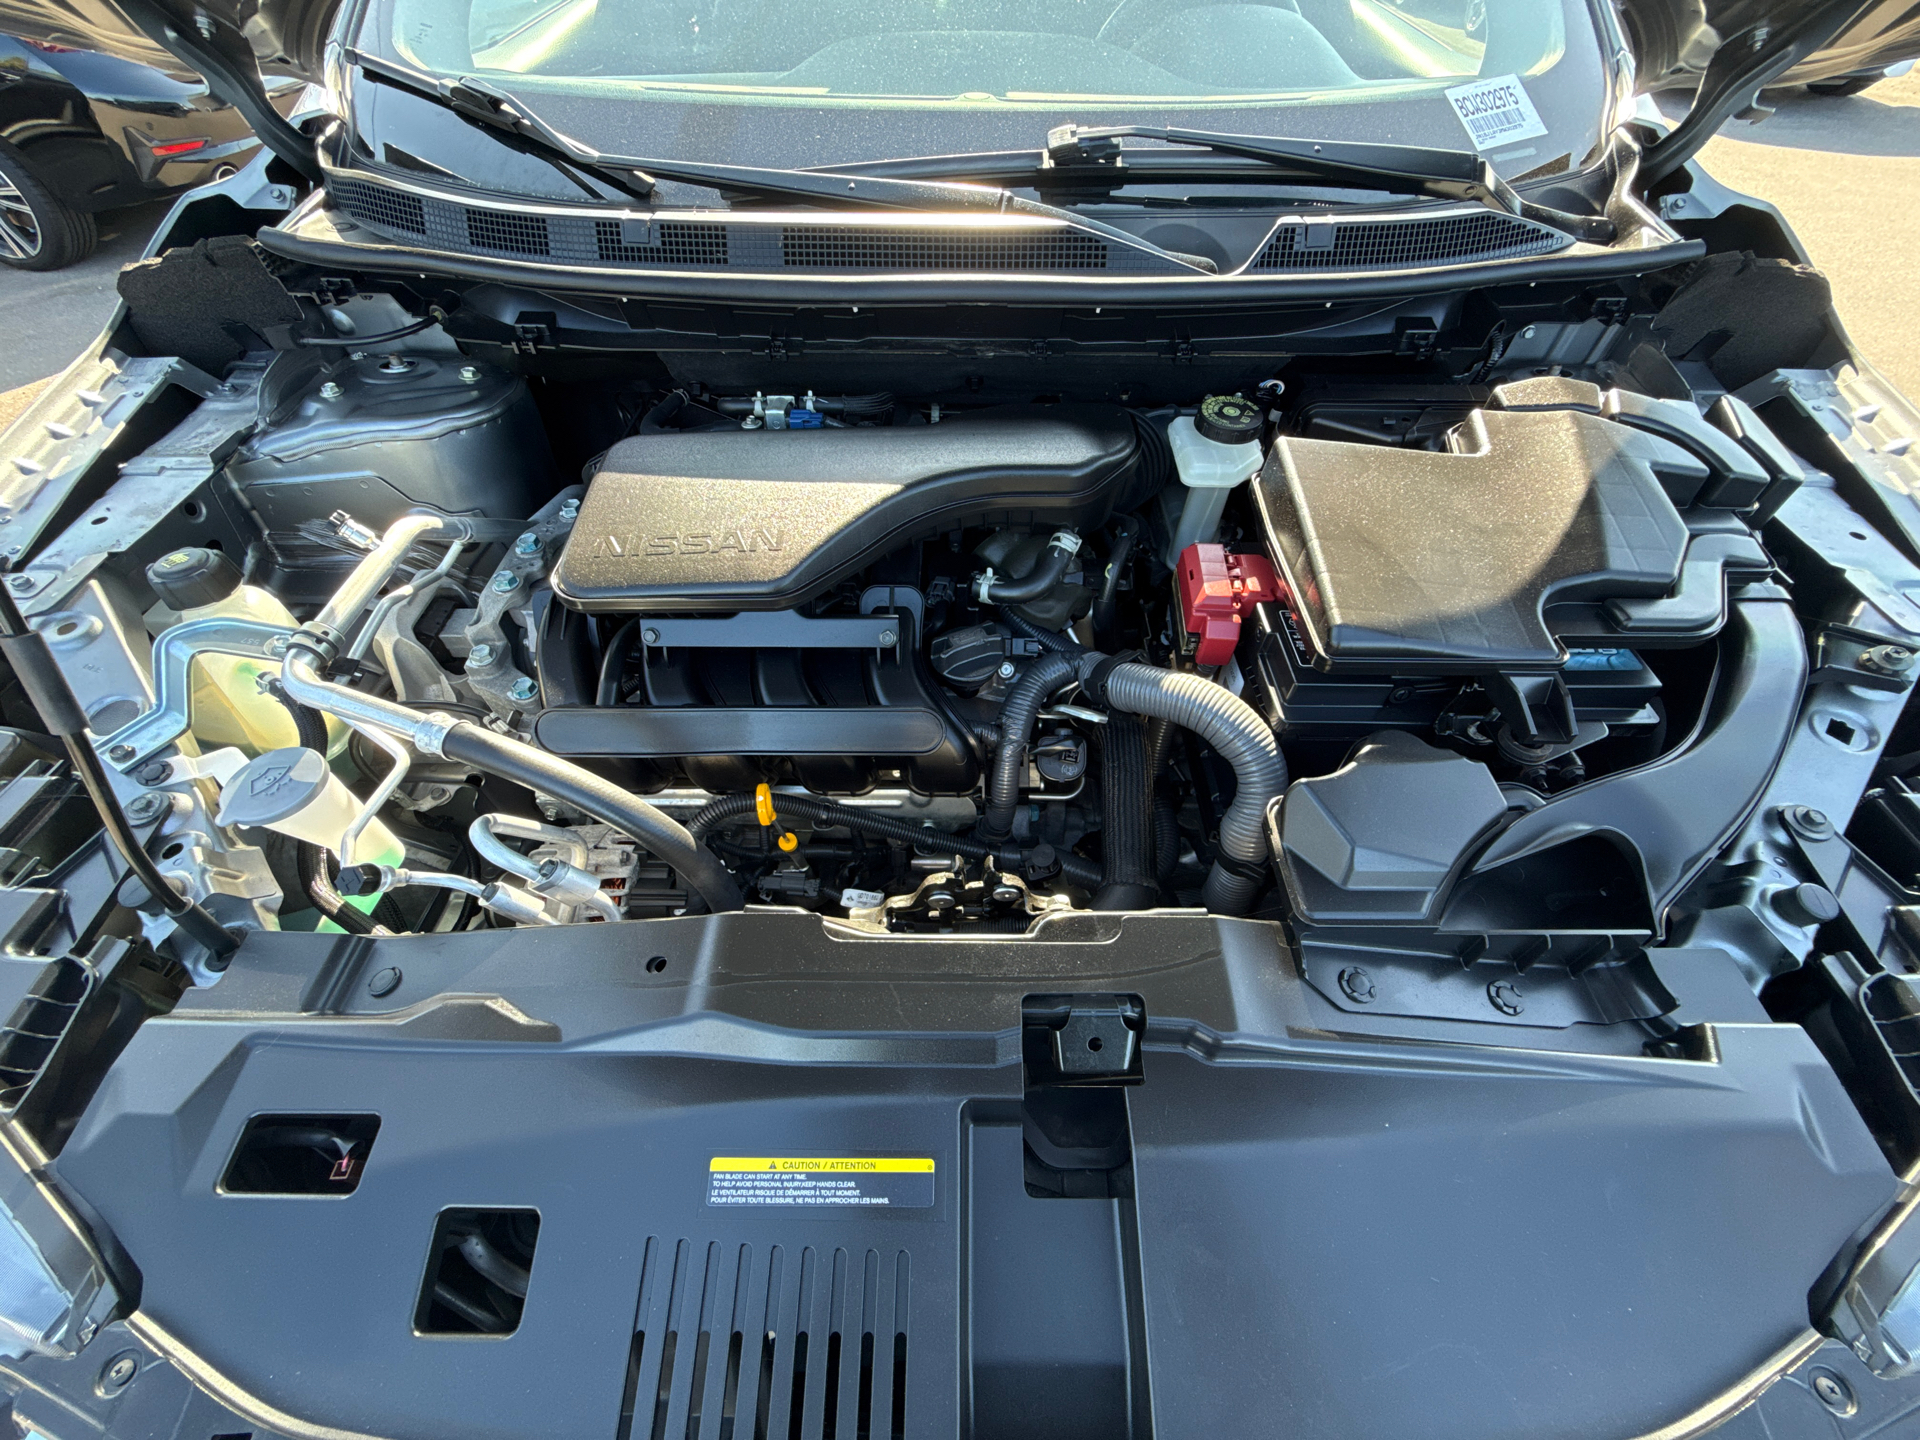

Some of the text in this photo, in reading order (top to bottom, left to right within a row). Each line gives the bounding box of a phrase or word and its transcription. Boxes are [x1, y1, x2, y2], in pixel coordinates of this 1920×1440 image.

[1454, 85, 1519, 118] BCW302975
[593, 530, 784, 559] NISSAN
[782, 1162, 876, 1170] CAUTION / ATTENTION
[785, 1188, 815, 1196] DÉMARRER
[815, 1188, 820, 1196] À
[728, 1195, 746, 1203] ÉVITER
